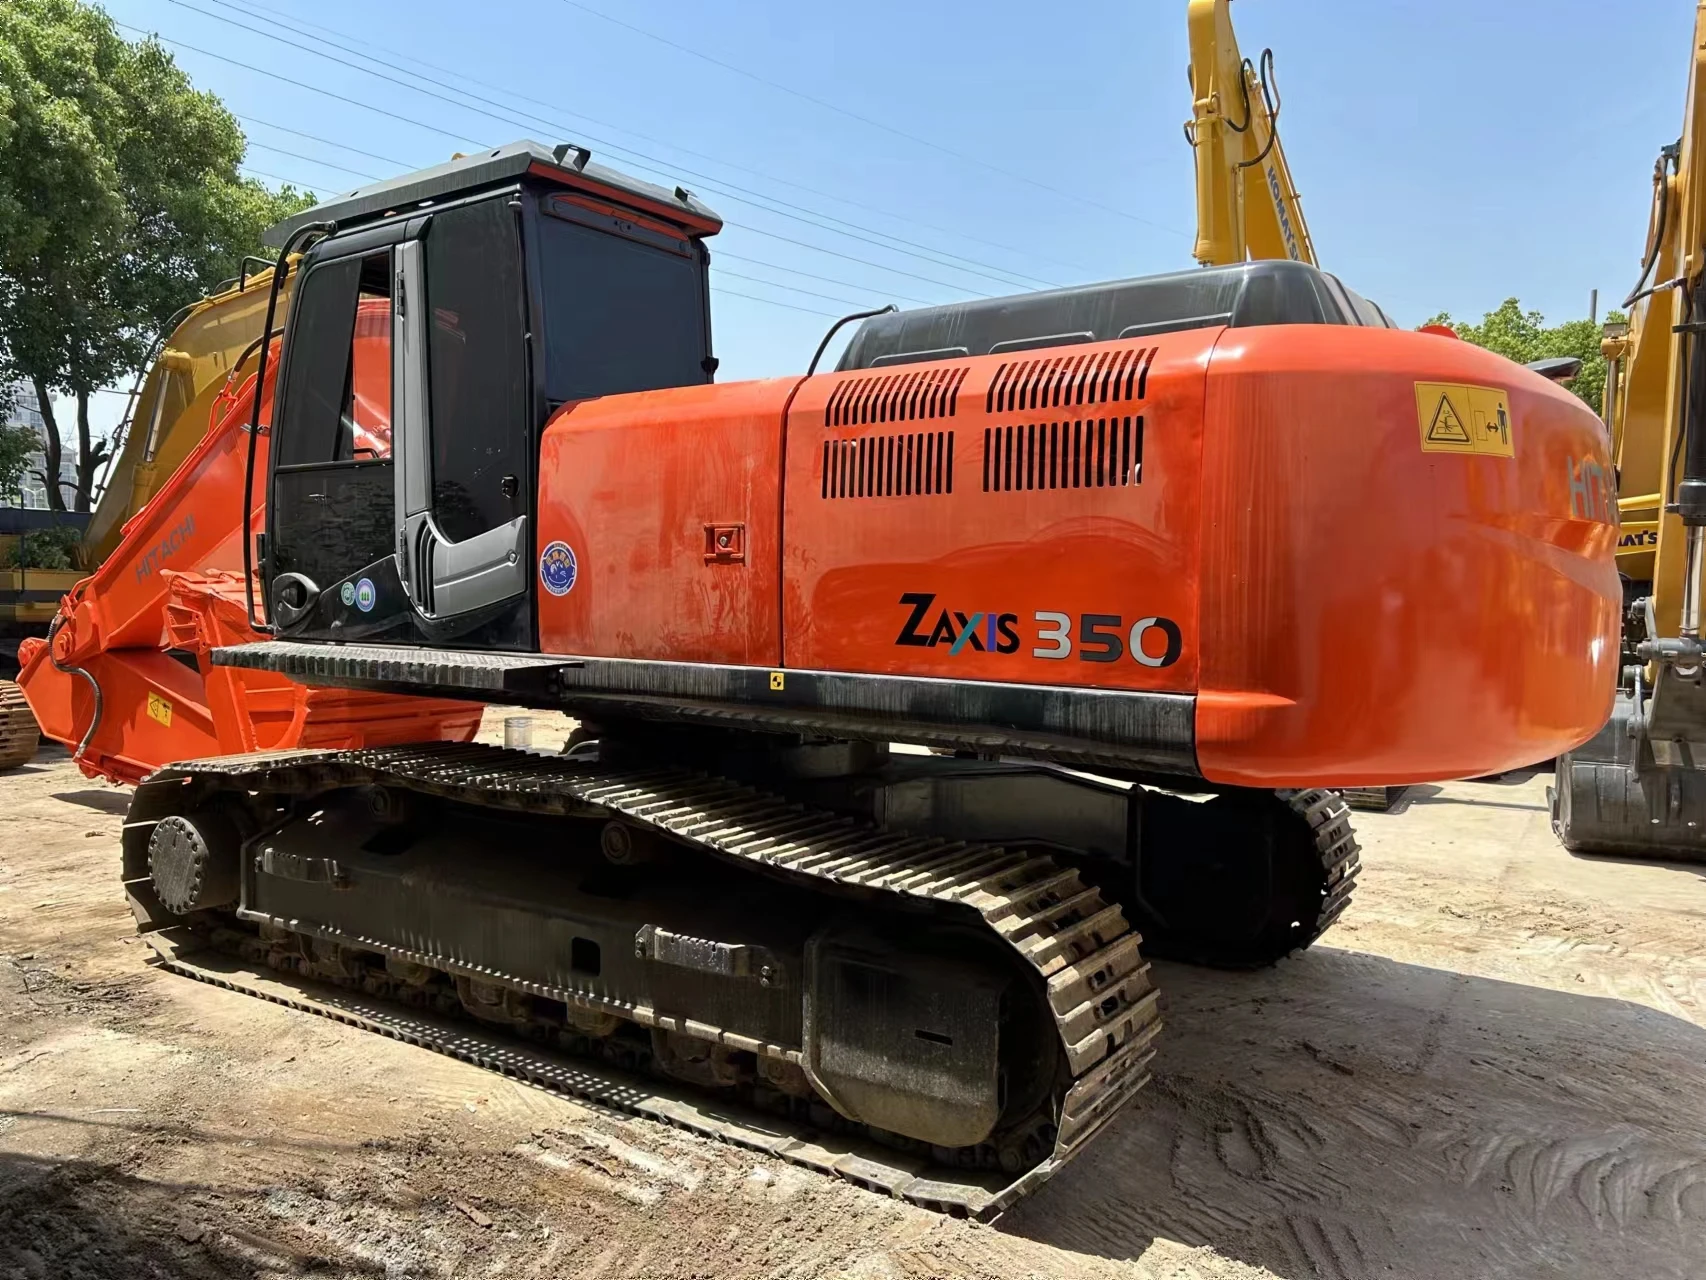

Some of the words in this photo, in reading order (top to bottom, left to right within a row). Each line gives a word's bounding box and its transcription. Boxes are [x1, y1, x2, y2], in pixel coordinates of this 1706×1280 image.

[1267, 166, 1300, 261] KOMATS
[135, 513, 196, 585] HITACHI
[895, 593, 1020, 655] ZAXIS
[1032, 610, 1182, 668] 350
